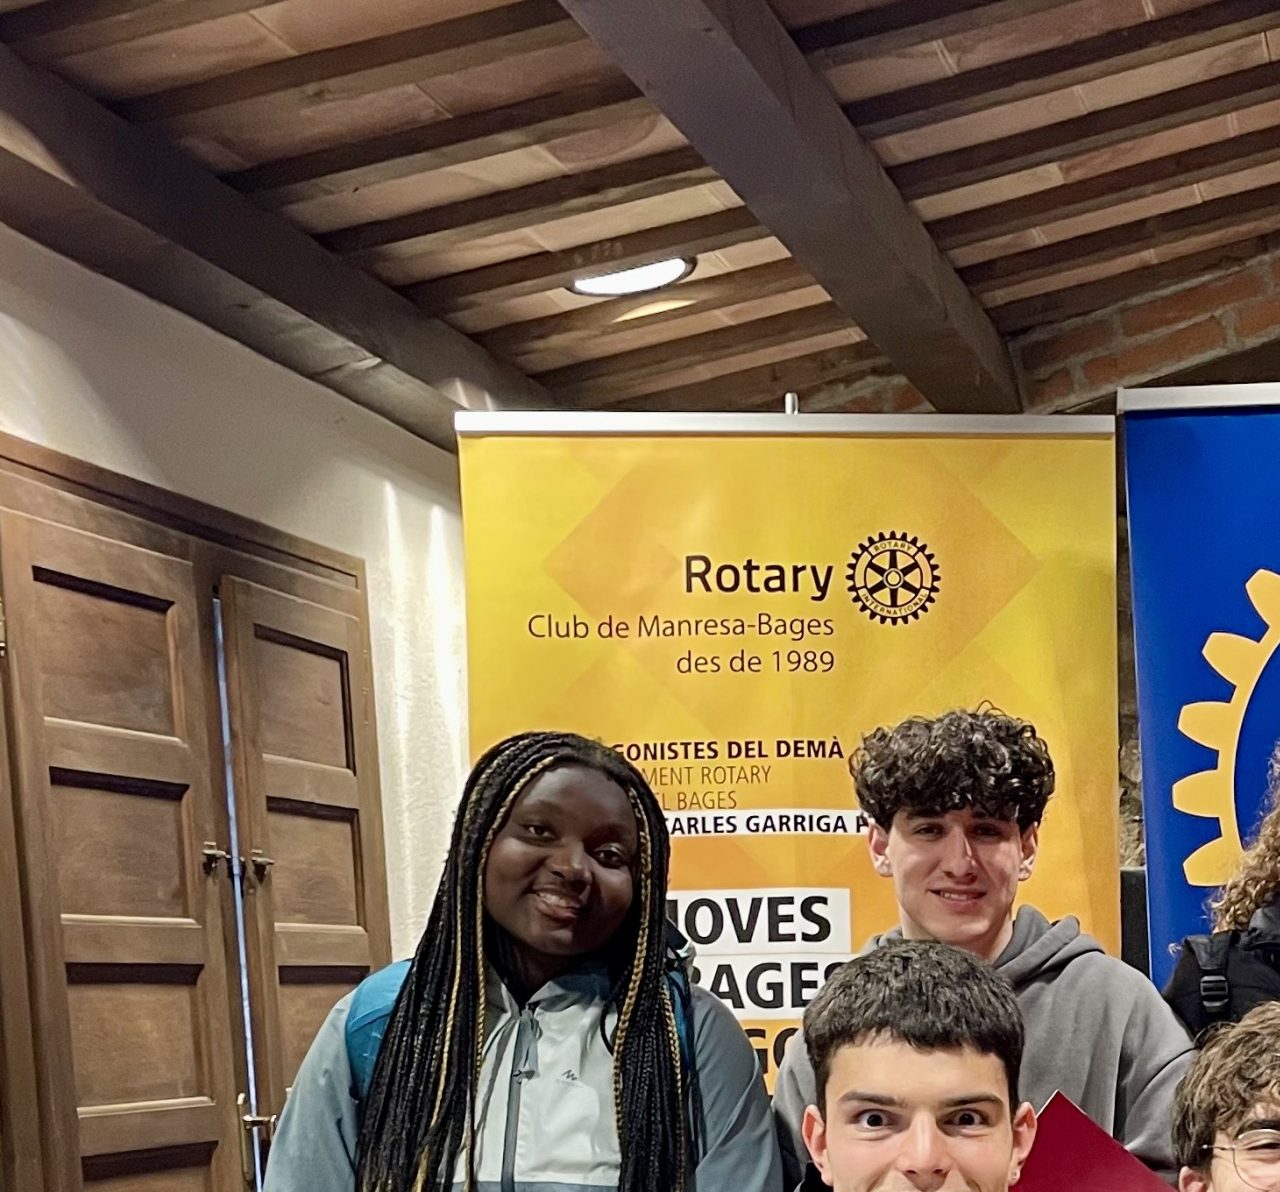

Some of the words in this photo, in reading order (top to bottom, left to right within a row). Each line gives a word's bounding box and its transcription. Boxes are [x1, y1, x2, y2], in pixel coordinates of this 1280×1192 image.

[874, 541, 913, 552] ROTARY
[685, 555, 833, 602] Rotary
[861, 592, 928, 615] INTERNATIONAL
[528, 614, 589, 639] Club
[597, 615, 629, 639] de
[638, 612, 835, 642] Manresa-Bages
[676, 650, 721, 674] des
[729, 650, 761, 673] de
[773, 650, 835, 673] 1989
[727, 741, 768, 759] DEL
[776, 736, 844, 758] DEMÀ
[701, 765, 771, 785] ROTARY
[677, 791, 737, 810] BAGES
[665, 815, 737, 835] ARLES
[746, 815, 848, 833] GARRIGA
[691, 962, 848, 1009] AGE
